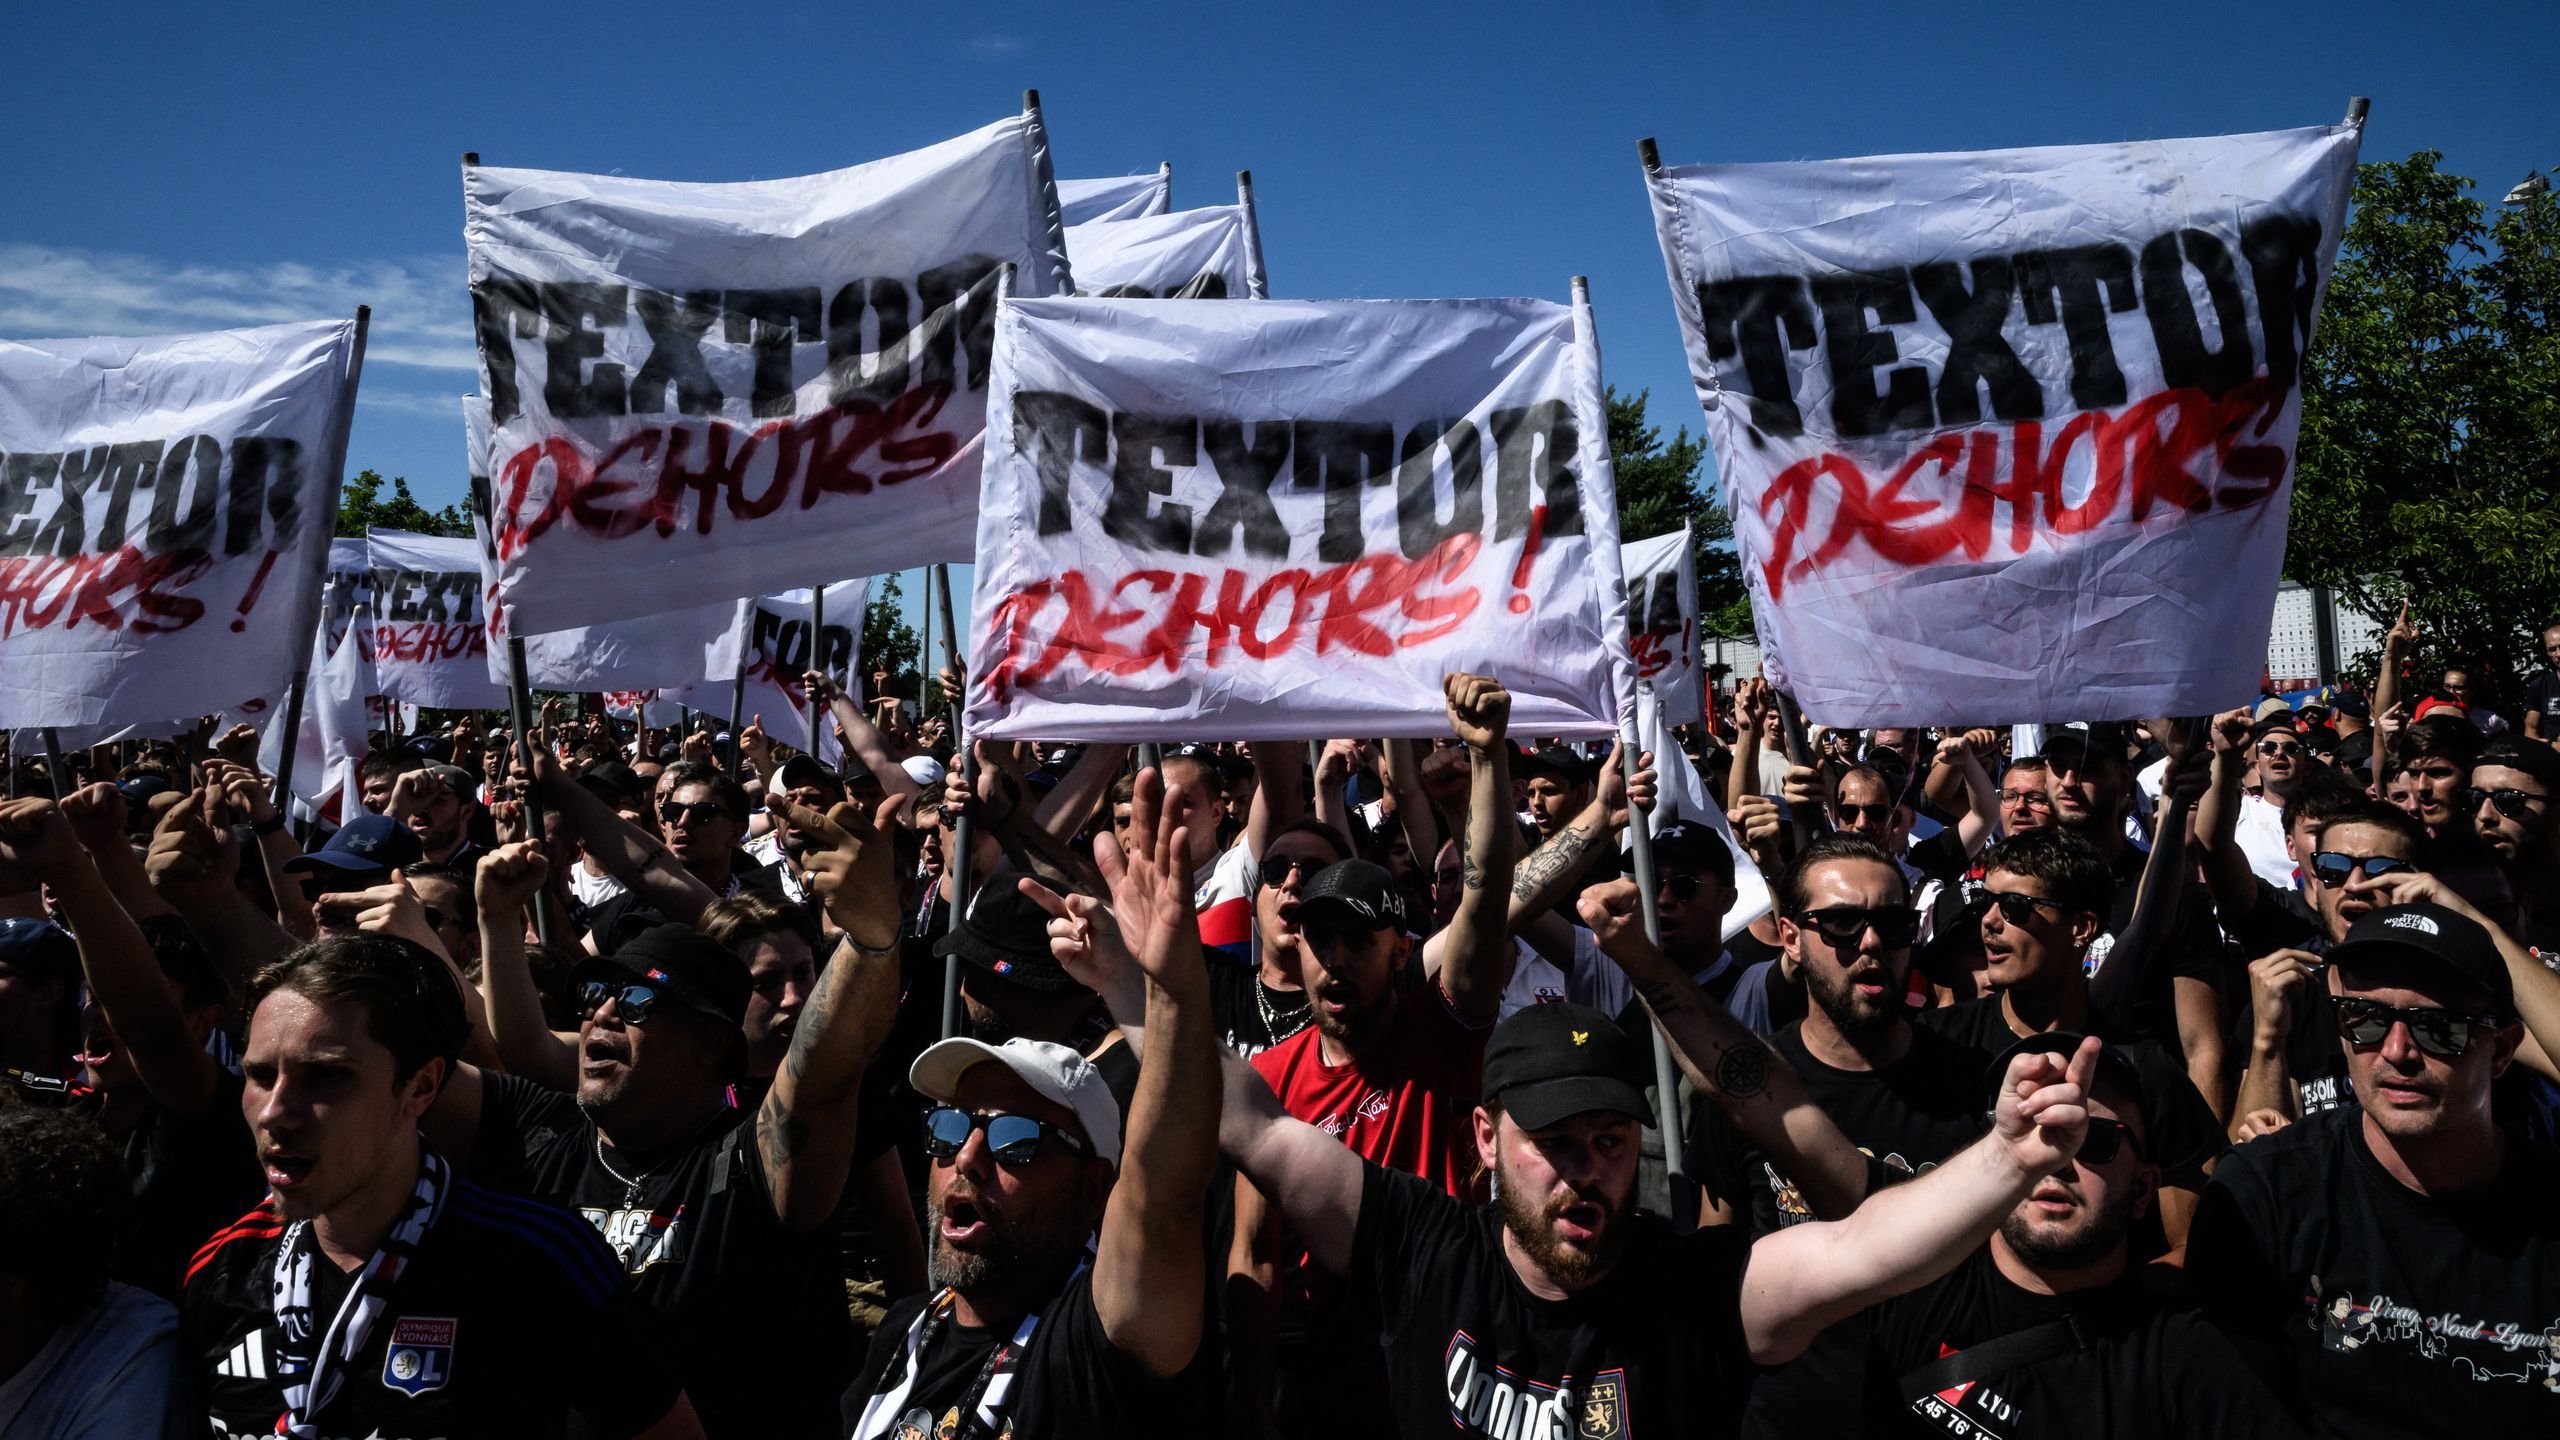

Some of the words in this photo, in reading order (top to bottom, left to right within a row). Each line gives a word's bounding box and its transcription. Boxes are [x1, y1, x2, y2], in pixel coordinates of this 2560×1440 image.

[0, 434, 303, 557] EXTOR
[498, 378, 960, 562] DEHORS
[1011, 392, 1585, 562] TEXTOR
[1760, 377, 2287, 604] DEHORS
[370, 566, 482, 622] TEXT
[980, 532, 1480, 702] DEHORS
[752, 606, 853, 690] TOR
[396, 1332, 450, 1344] LYONNAIS
[400, 1322, 451, 1334] OLYMPIQUE
[2369, 1294, 2424, 1328] Virag
[2426, 1312, 2486, 1340] Nord
[2488, 1322, 2550, 1352] Lyon
